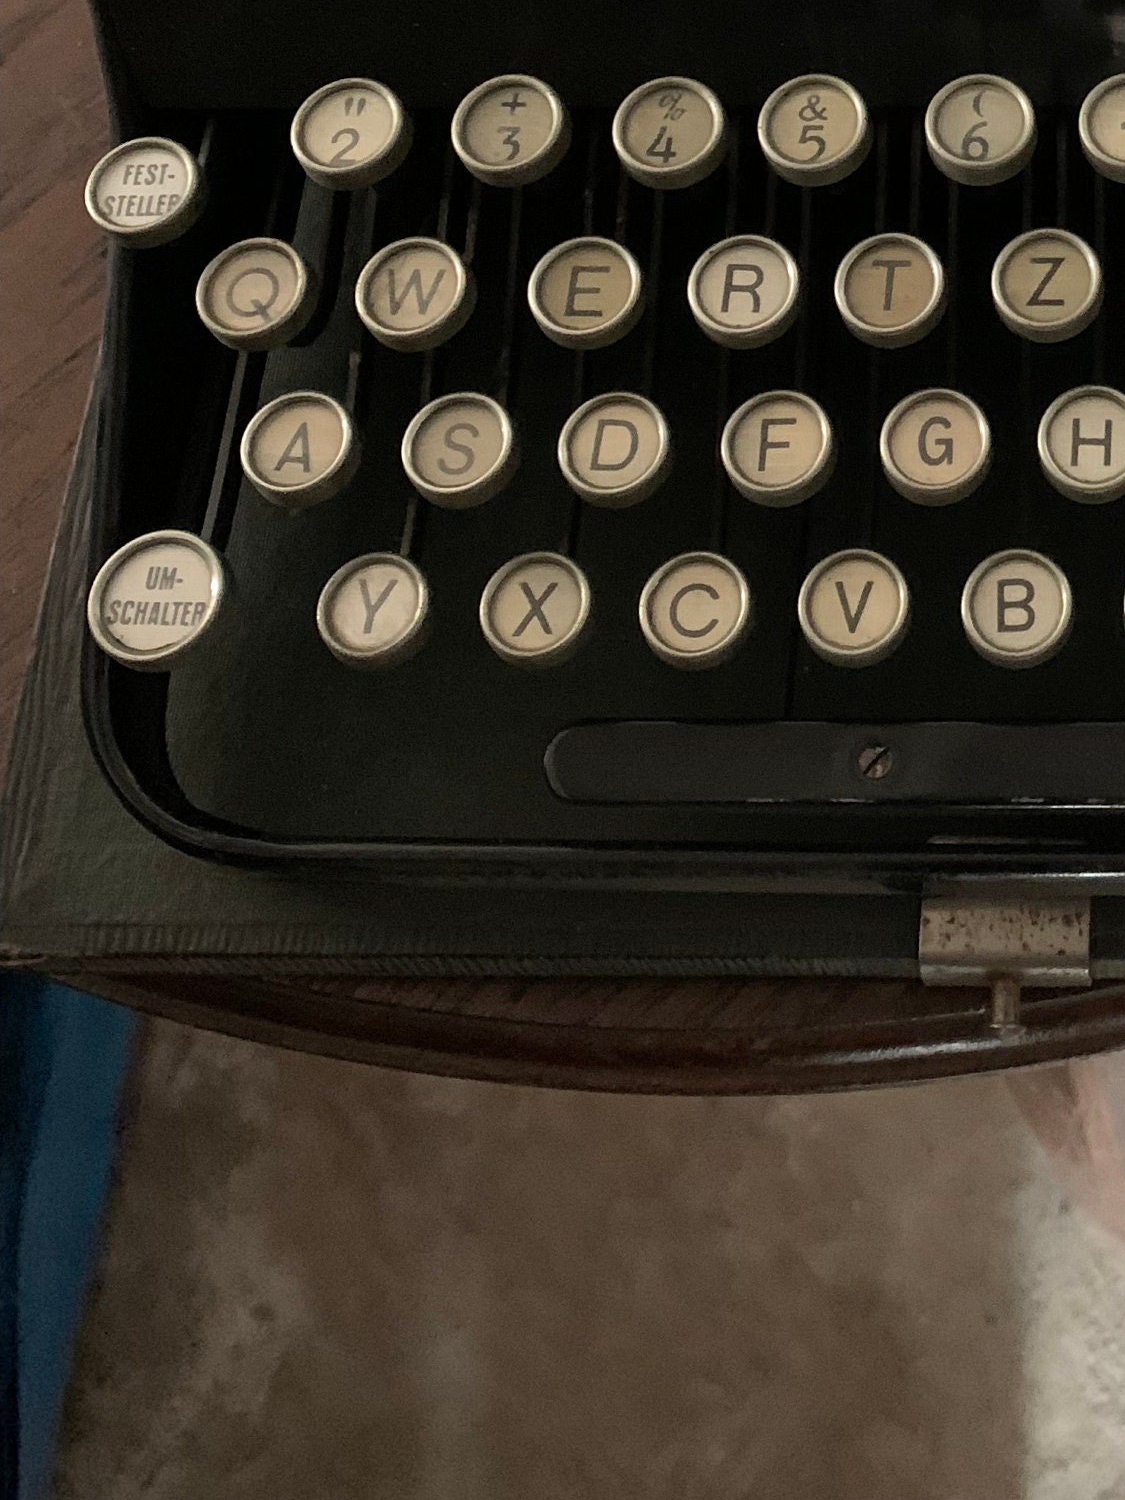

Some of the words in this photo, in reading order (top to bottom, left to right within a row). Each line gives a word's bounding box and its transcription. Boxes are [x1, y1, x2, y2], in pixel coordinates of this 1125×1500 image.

[798, 94, 827, 121] &
[330, 129, 360, 164] 2
[497, 126, 521, 160] 3
[645, 126, 677, 163] 4
[798, 125, 827, 162] 5
[961, 121, 989, 161] 6
[122, 164, 175, 186] FEST-
[103, 194, 181, 216] STELLER
[226, 267, 280, 323] Q
[385, 268, 446, 315] W
[564, 265, 611, 317] E
[720, 263, 764, 314] R
[872, 259, 911, 312] T
[1026, 257, 1066, 307] Z
[274, 422, 311, 473] A
[437, 423, 480, 475] S
[590, 419, 639, 471] D
[757, 418, 798, 472] F
[918, 416, 954, 467] G
[1070, 418, 1113, 467] H
[145, 566, 184, 590] UM-
[105, 600, 207, 628] SCHALTER
[358, 579, 398, 634] Y
[512, 581, 559, 637] X
[669, 583, 721, 638] C
[835, 580, 875, 634] V
[997, 578, 1036, 633] B
